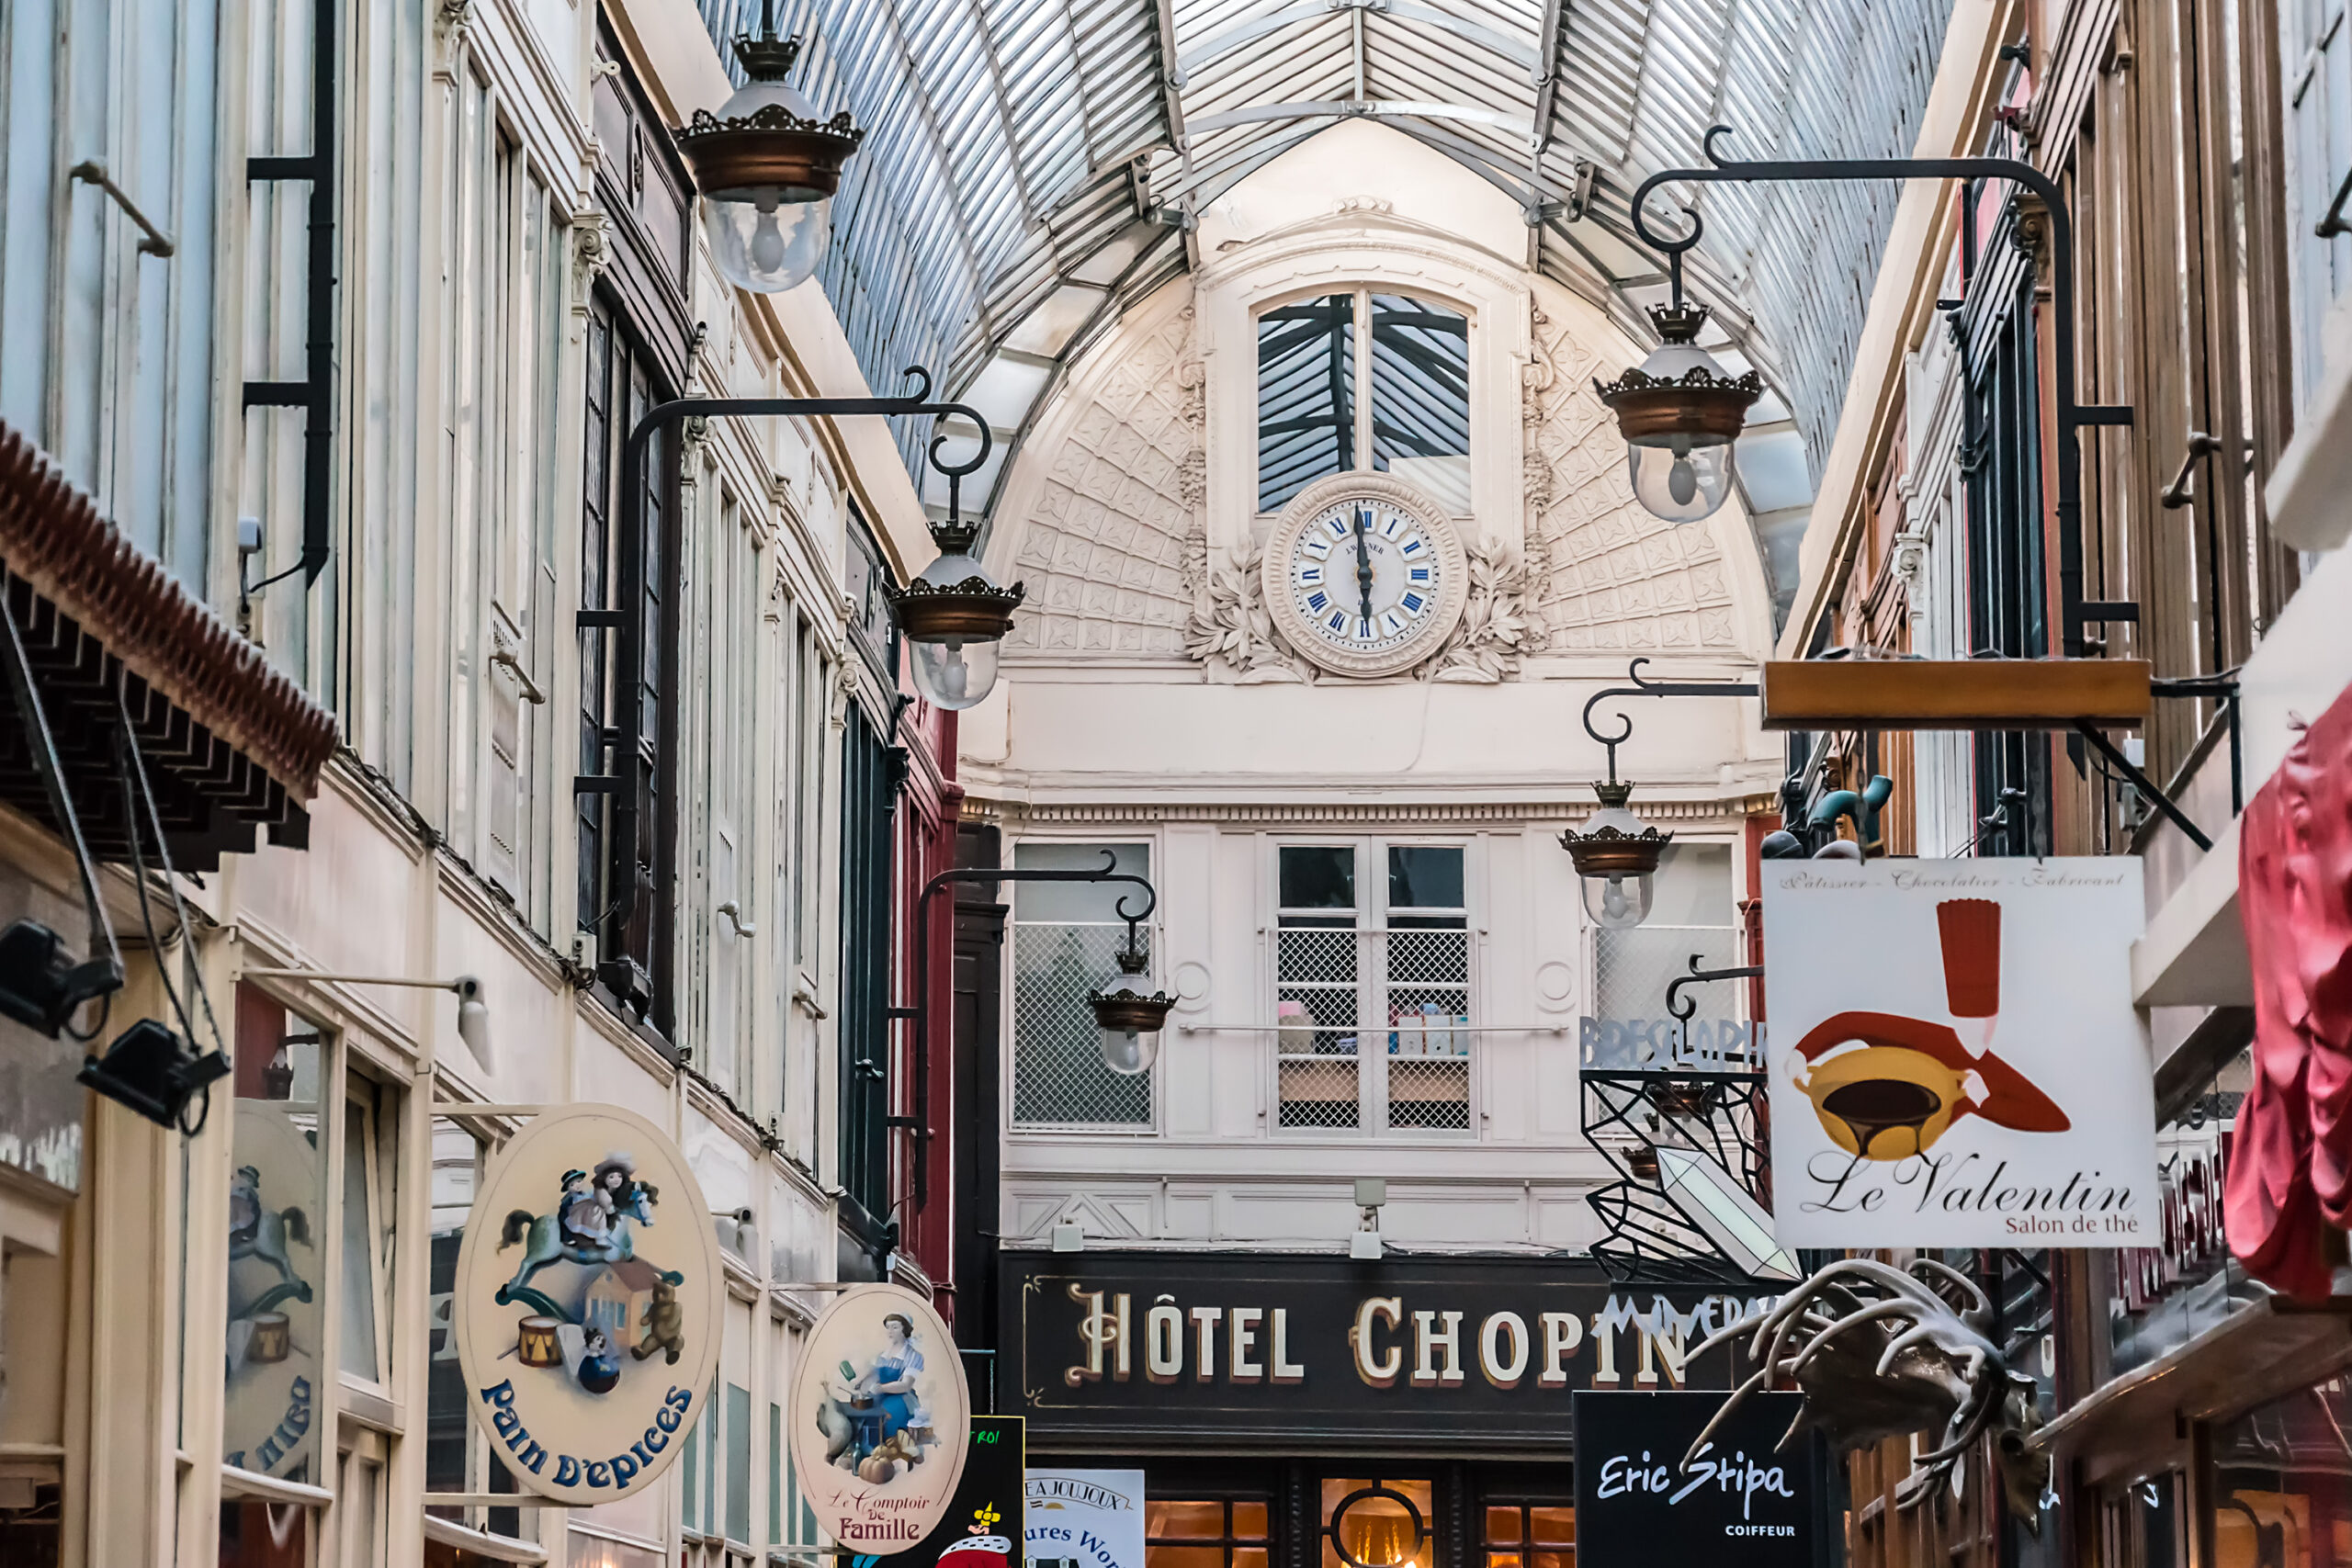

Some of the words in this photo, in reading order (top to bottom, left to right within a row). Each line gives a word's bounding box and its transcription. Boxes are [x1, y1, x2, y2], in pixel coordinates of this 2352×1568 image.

[1891, 868, 2001, 890] Chocolatier
[2022, 867, 2125, 887] Fabricant
[1800, 1150, 1887, 1213] Le
[1893, 1152, 2136, 1214] Valentin
[2006, 1215, 2064, 1235] Salon
[2072, 1214, 2098, 1235] de
[2105, 1213, 2140, 1235] thé
[1065, 1282, 1305, 1387] HÔTEL
[1348, 1295, 1686, 1390] CHOPIN
[977, 1429, 1000, 1444] ROI
[1049, 1480, 1122, 1511] JOUJOUX
[1598, 1450, 1670, 1499] Eric
[1668, 1442, 1794, 1521] Stipa
[849, 1487, 931, 1516] Comptoir
[838, 1517, 921, 1540] Famille
[1724, 1524, 1796, 1537] COIFFEUR
[1023, 1526, 1072, 1541] ures
[1079, 1529, 1126, 1568] Wor
